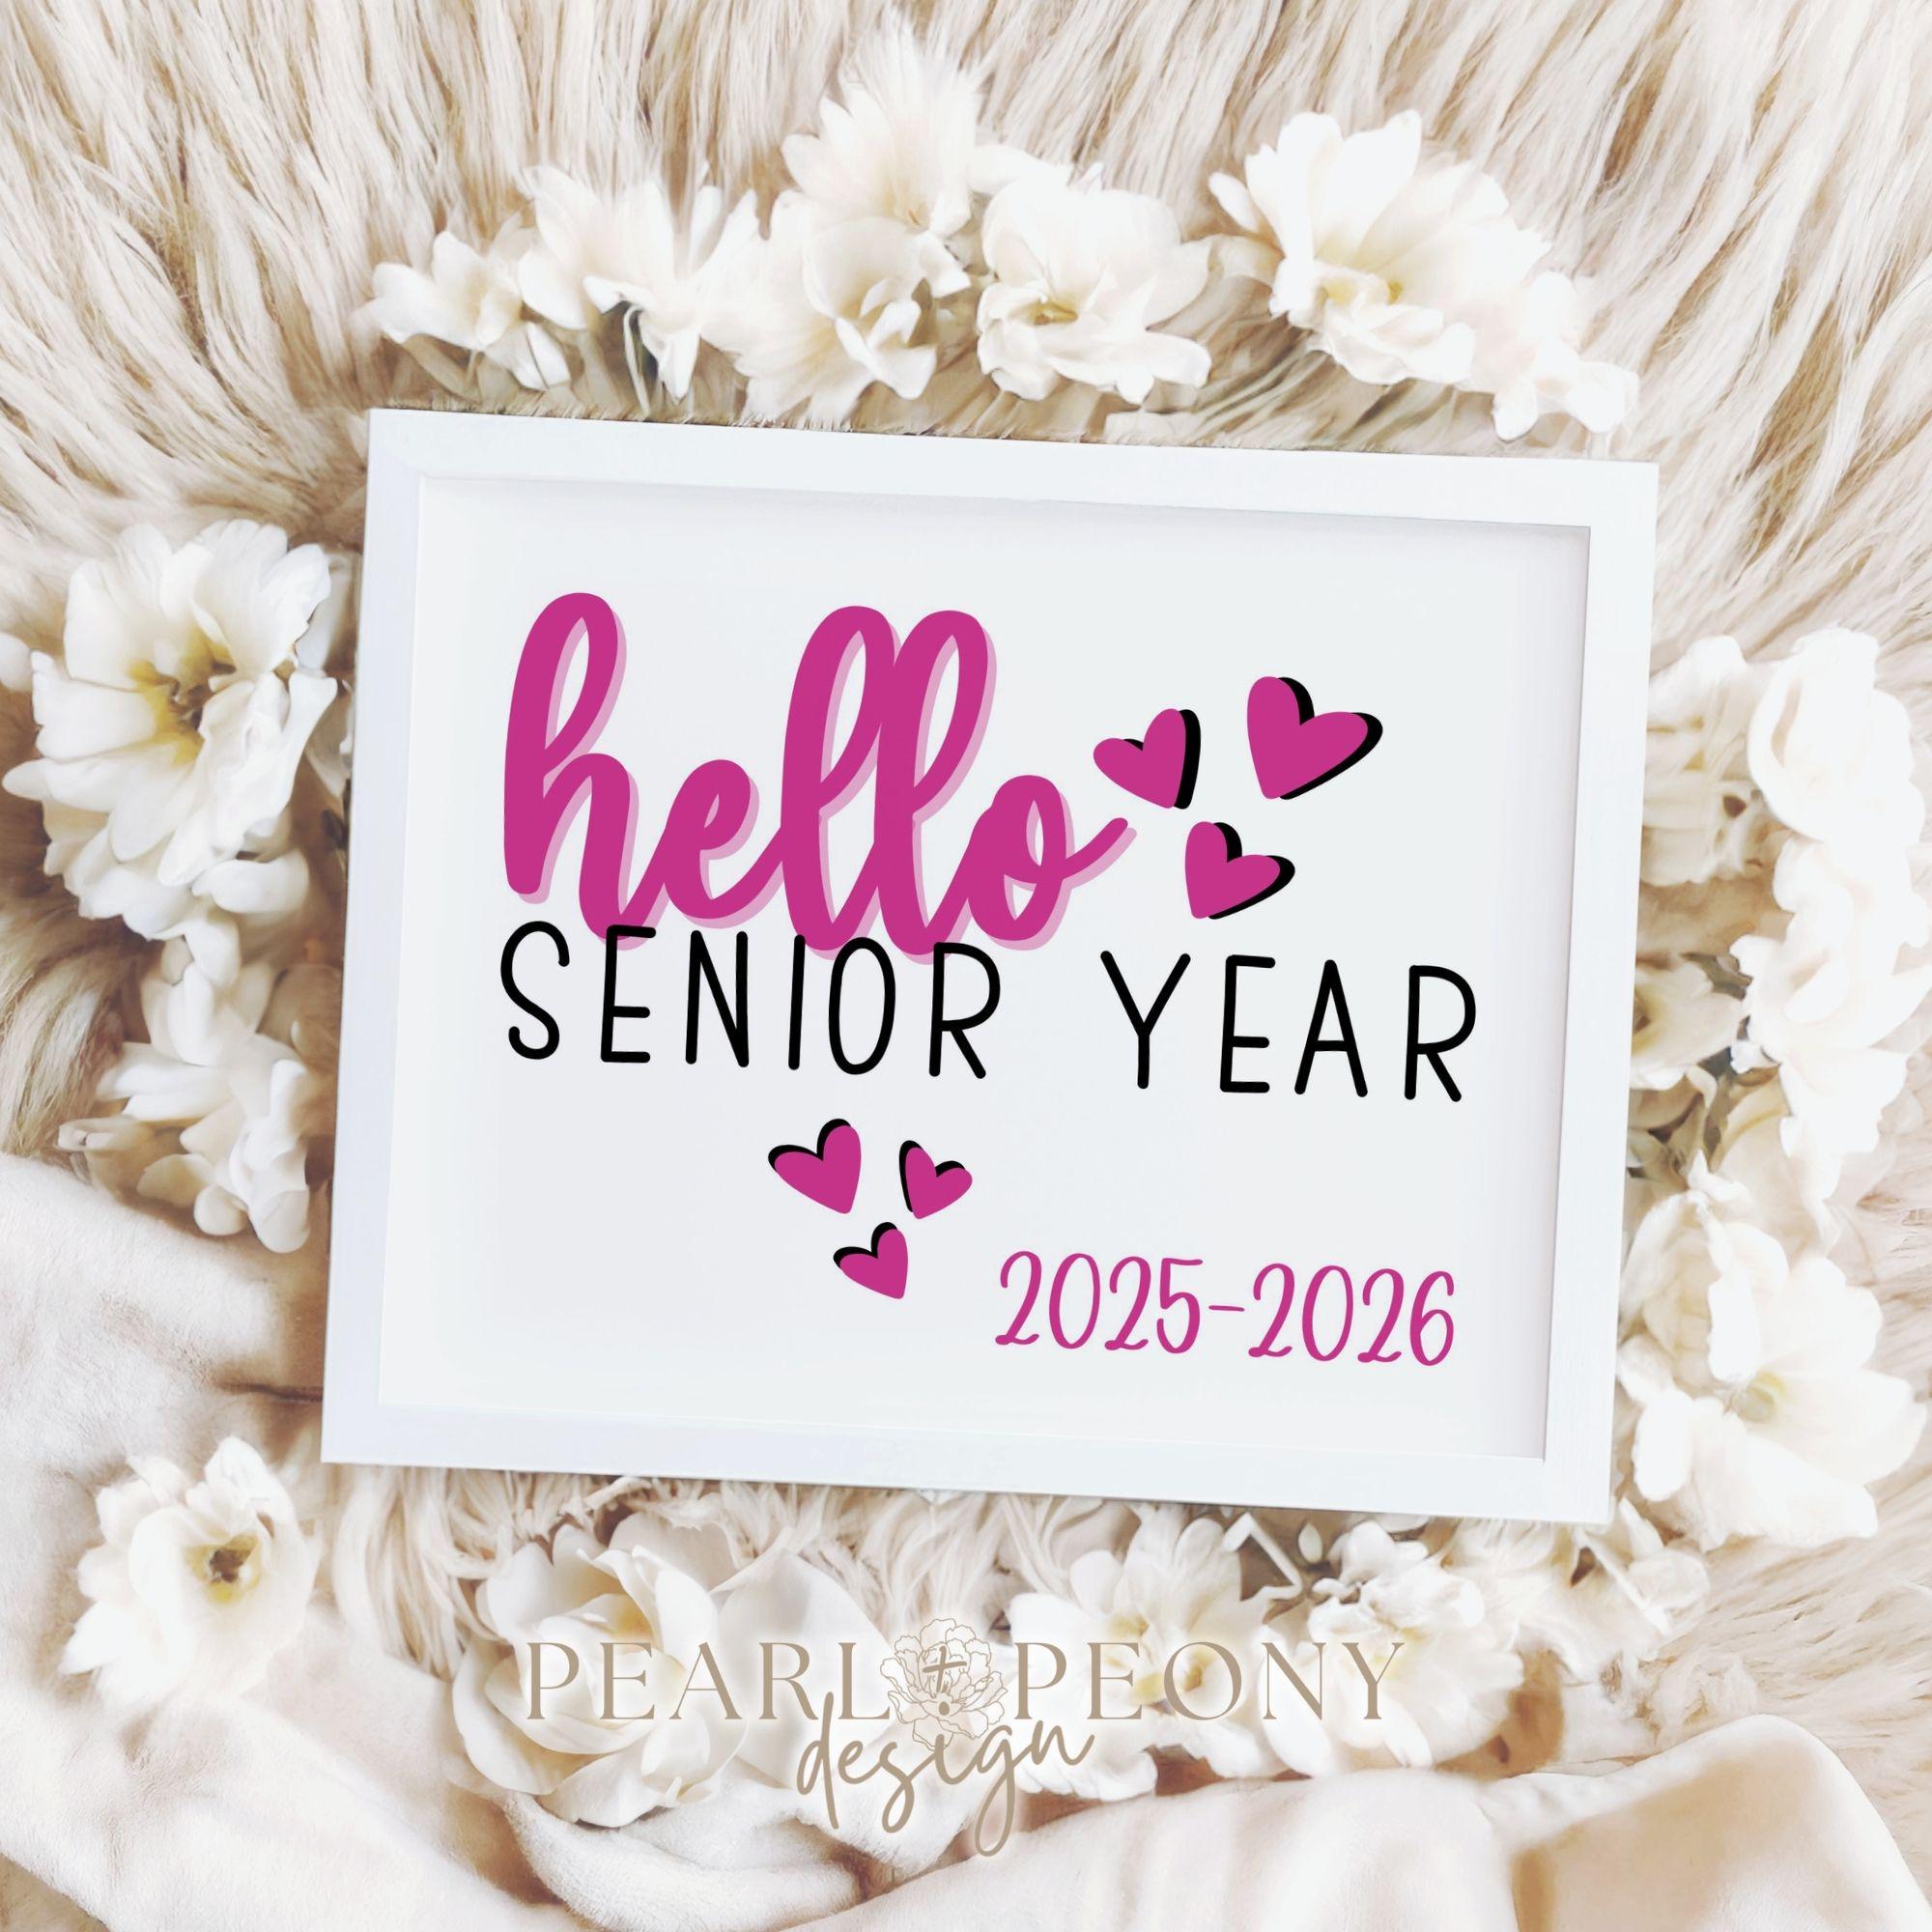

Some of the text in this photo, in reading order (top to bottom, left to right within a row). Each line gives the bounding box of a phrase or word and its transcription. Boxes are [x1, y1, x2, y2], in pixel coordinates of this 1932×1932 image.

[502, 591, 1136, 956] hello
[499, 921, 1477, 1103] SENIOR YEAR
[994, 1249, 1457, 1368] 2025-2026
